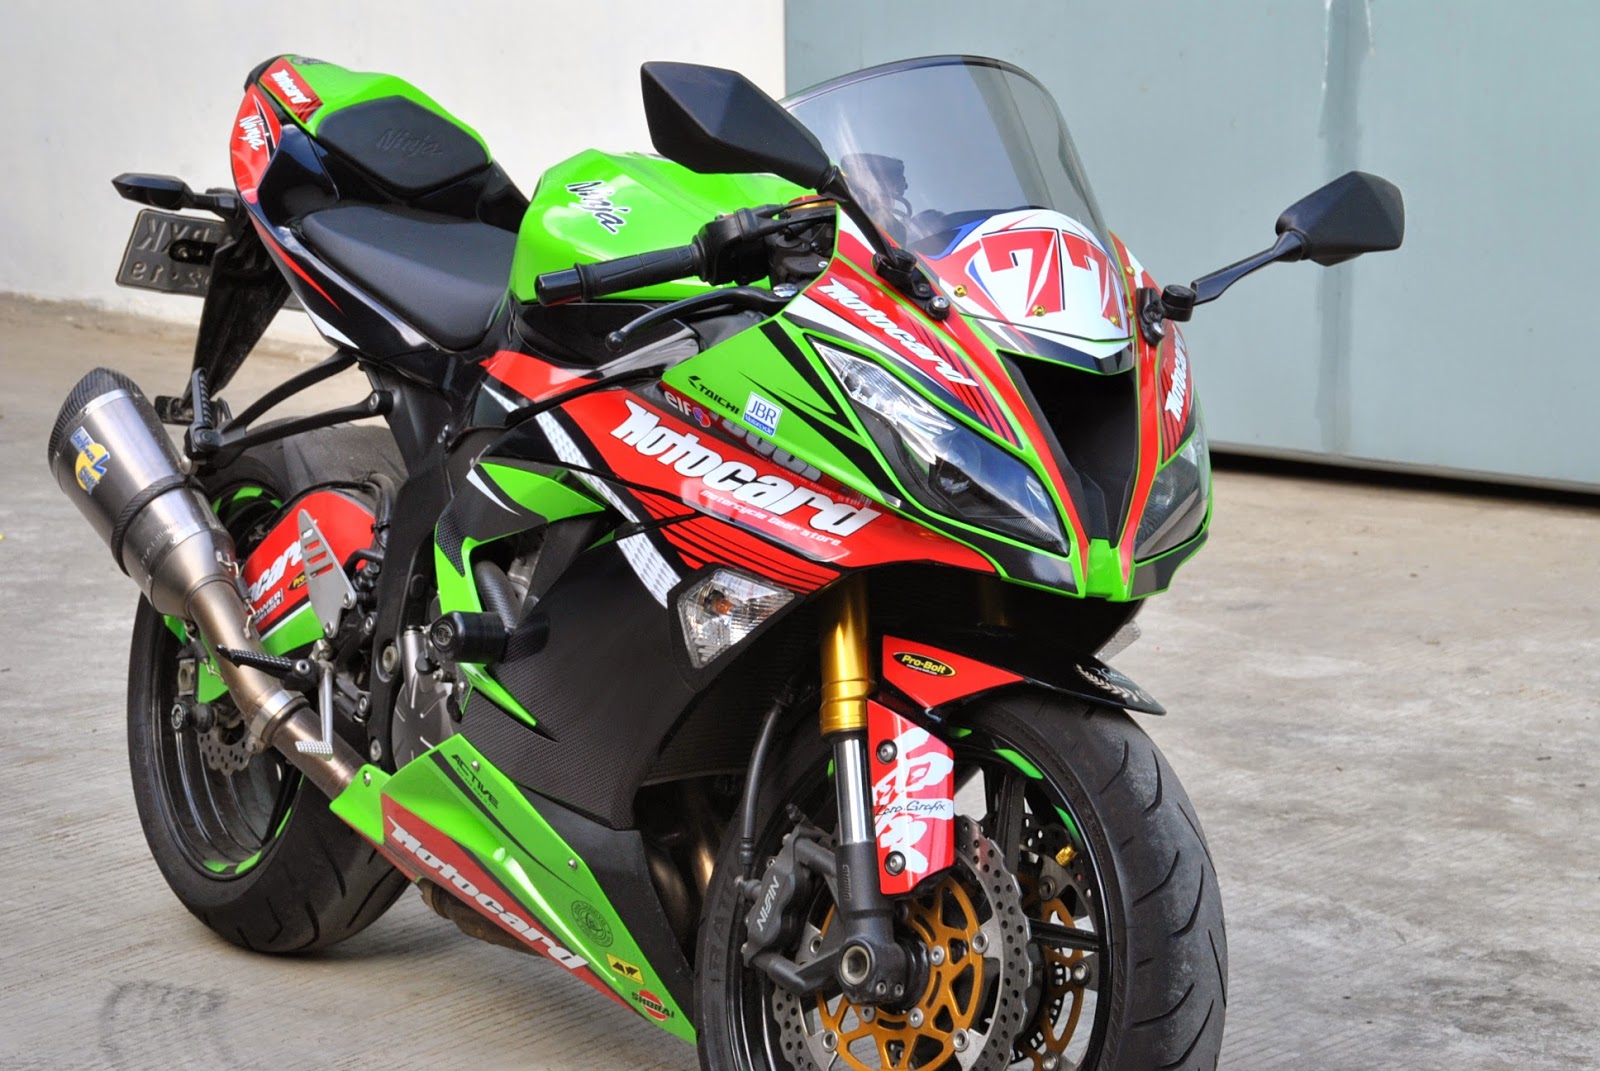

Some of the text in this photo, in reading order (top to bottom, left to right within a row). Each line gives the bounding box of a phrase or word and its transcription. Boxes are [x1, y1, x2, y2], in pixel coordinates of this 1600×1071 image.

[239, 114, 270, 151] Ninja
[566, 181, 632, 234] Ninja
[699, 384, 740, 414] TAICHI
[748, 400, 777, 425] JBR
[901, 654, 947, 674] Pro-Bolt
[451, 754, 499, 809] ACTIVE
[631, 991, 675, 1019] SHORAI
